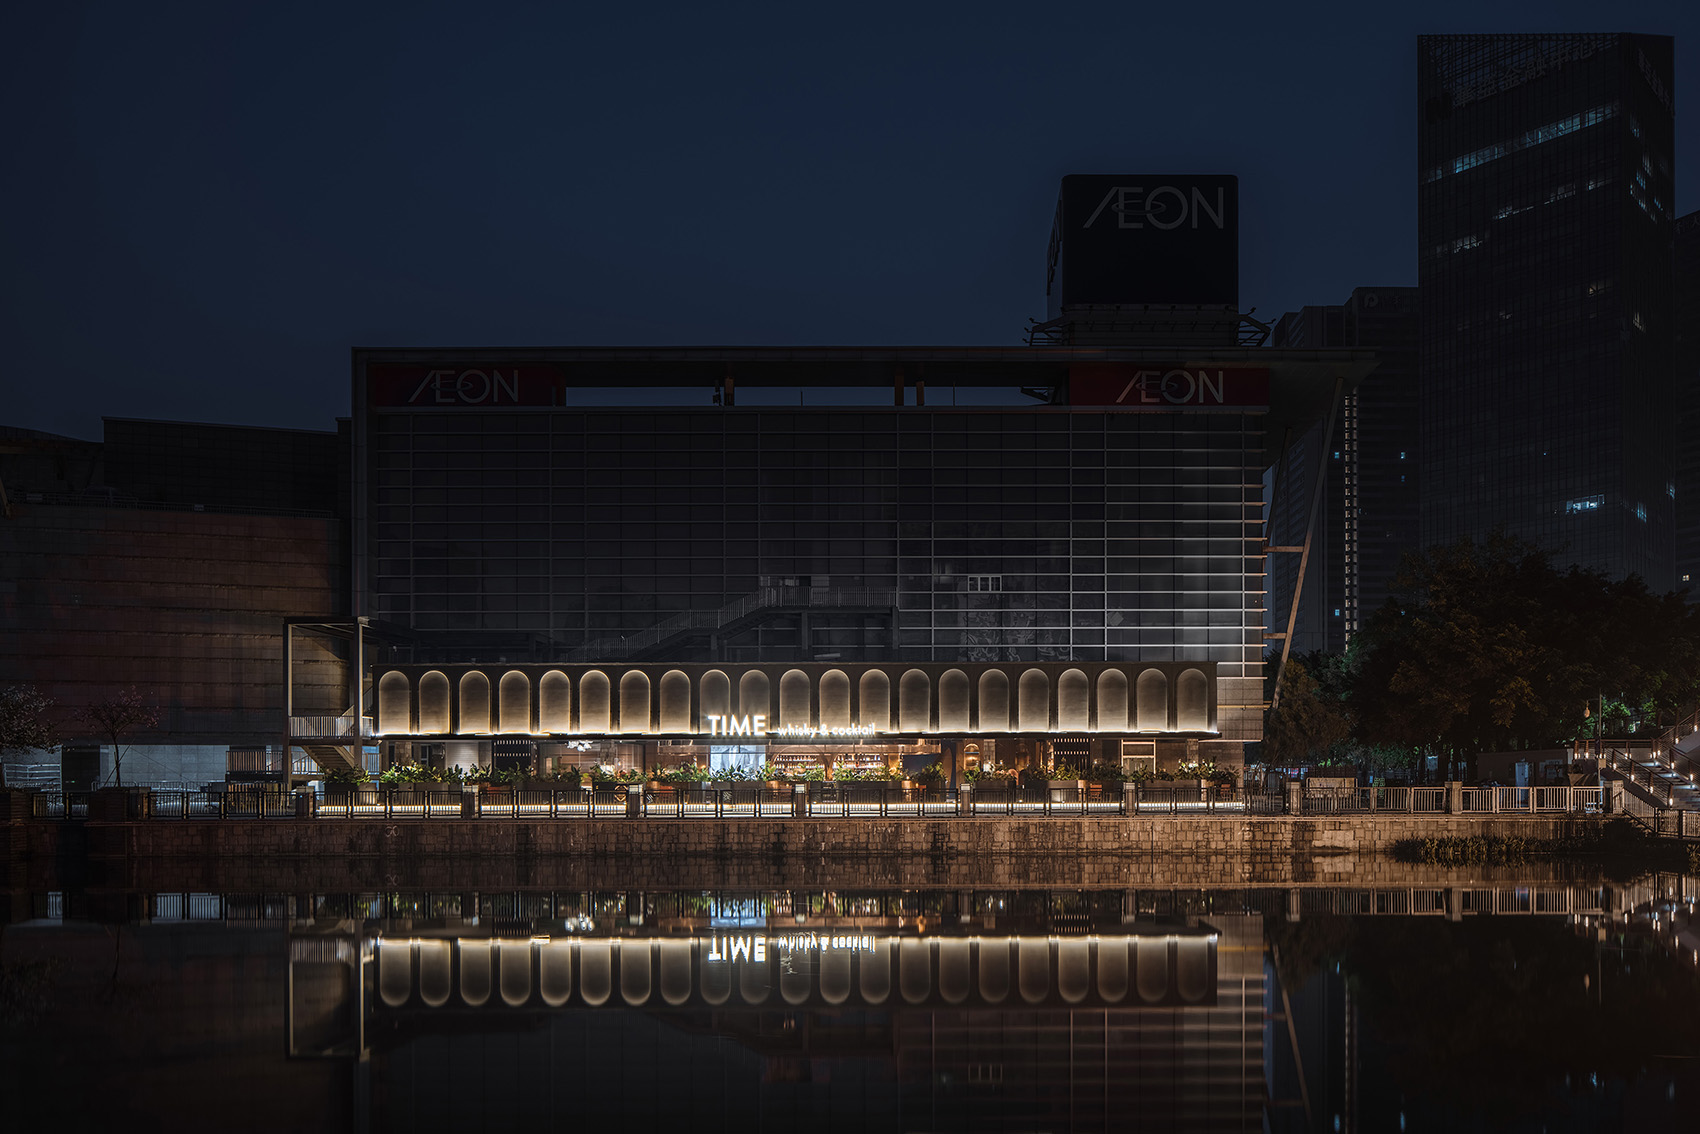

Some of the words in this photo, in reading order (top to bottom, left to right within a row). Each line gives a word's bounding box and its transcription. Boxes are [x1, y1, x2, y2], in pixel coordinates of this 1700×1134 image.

[707, 714, 767, 737] TIME
[777, 723, 817, 738] whisky
[819, 724, 829, 736] &
[831, 723, 876, 736] cocktail
